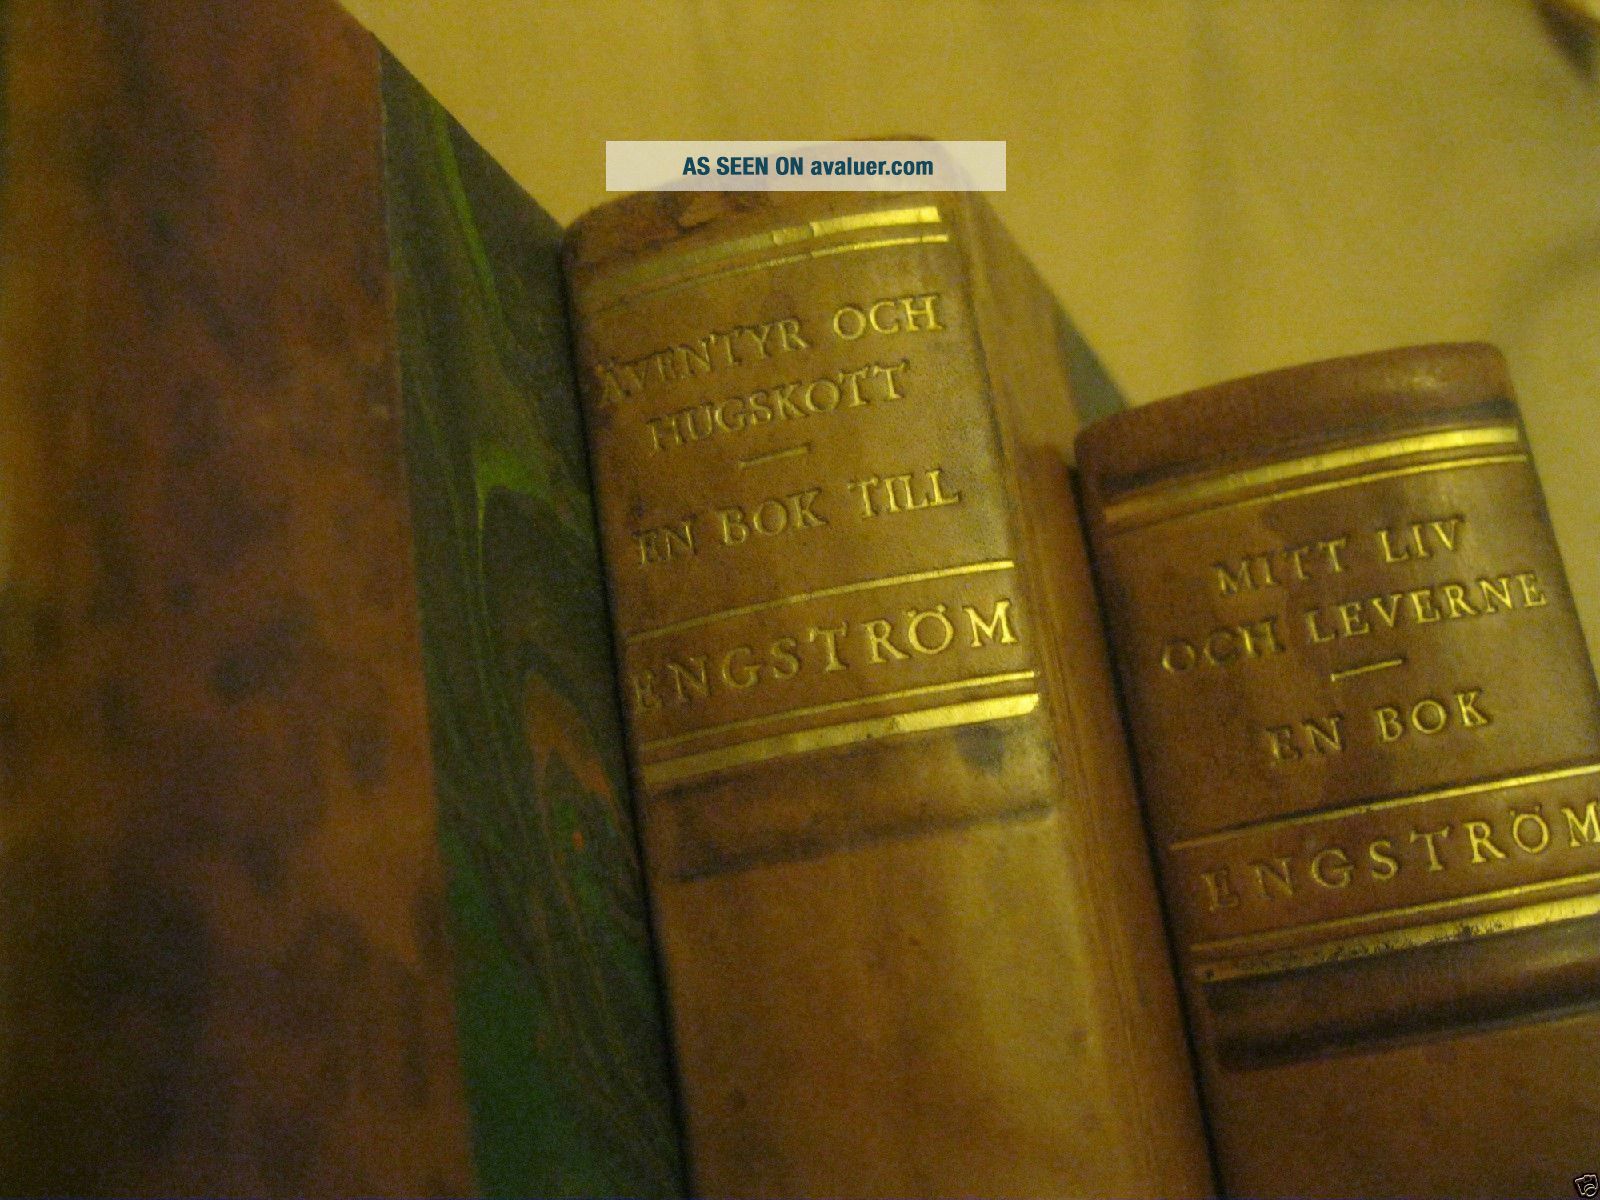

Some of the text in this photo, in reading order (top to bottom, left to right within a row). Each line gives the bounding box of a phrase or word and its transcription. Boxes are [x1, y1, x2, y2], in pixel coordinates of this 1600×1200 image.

[832, 294, 945, 342] OCH
[647, 359, 909, 454] HUGSKOTT
[633, 469, 960, 566] EN BOK TILL
[1214, 516, 1466, 597] MITT LIV
[629, 599, 1018, 714] ENGSTRÖM
[1160, 571, 1548, 675] OCH LEVERNE
[1266, 689, 1491, 765] EN BOK
[1200, 801, 1600, 913] ENGSTRÖM
